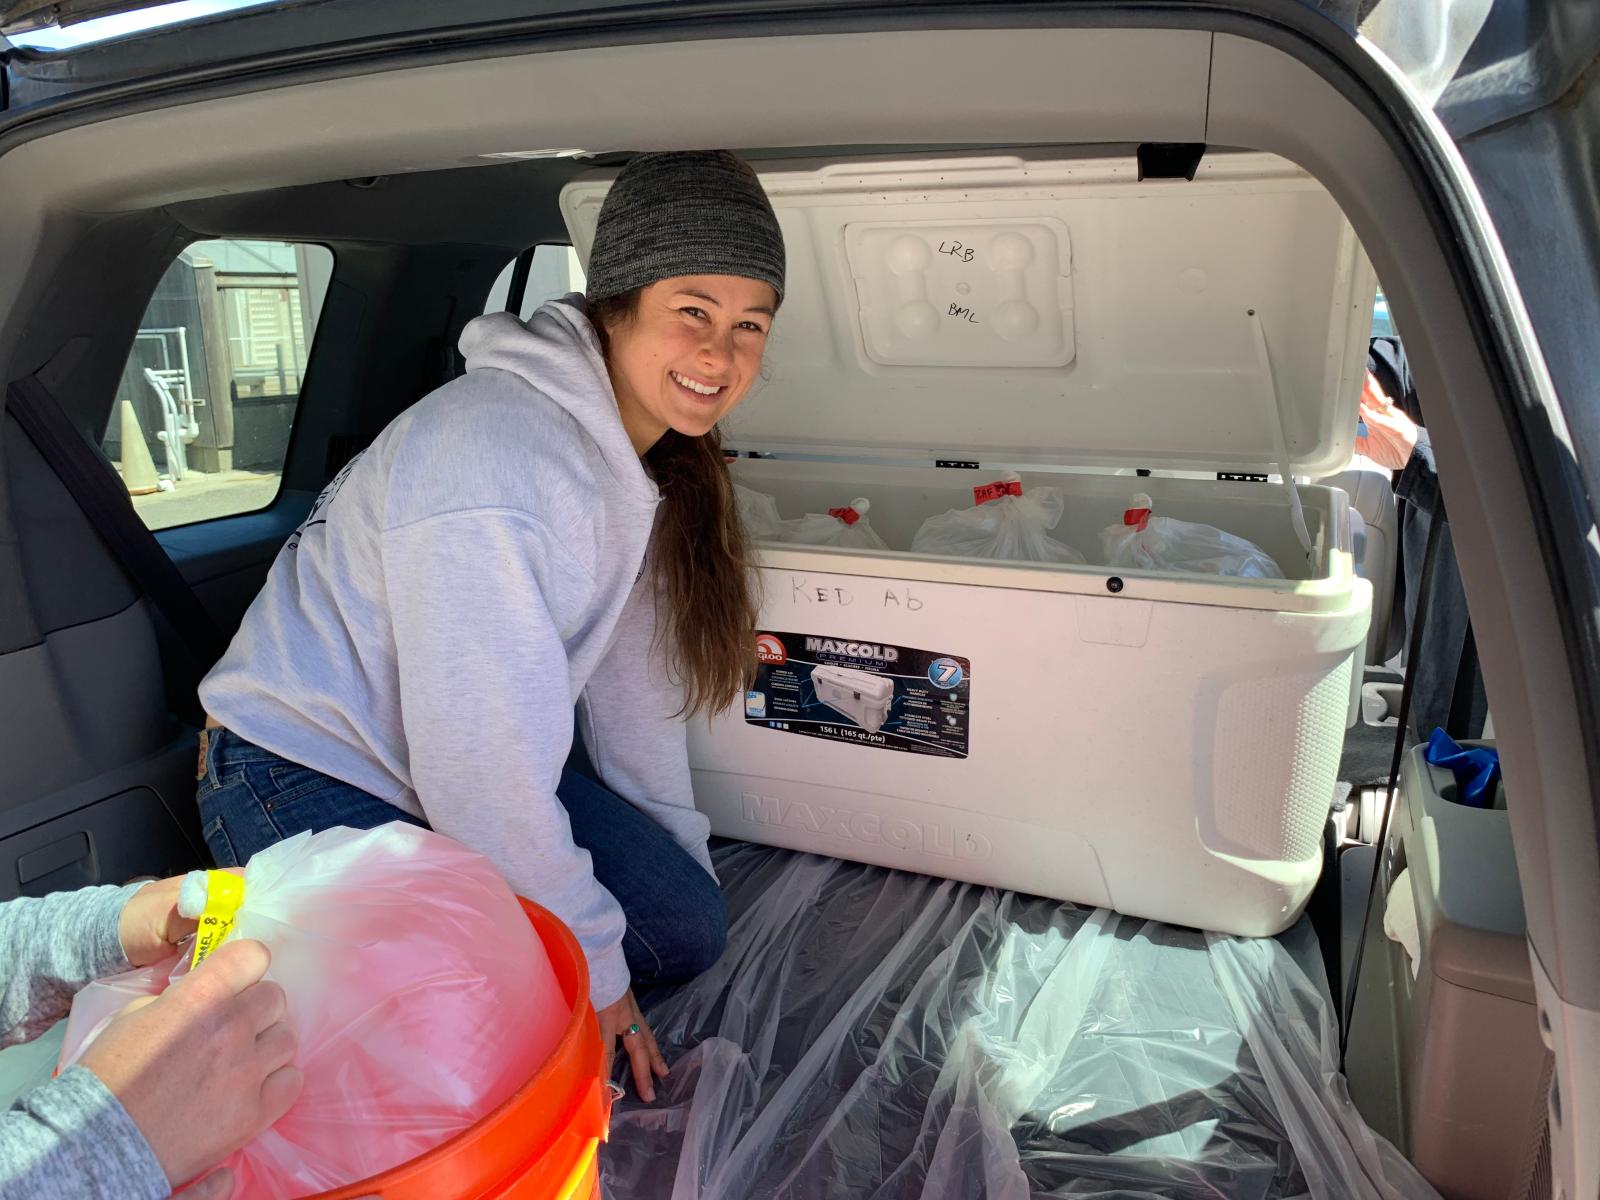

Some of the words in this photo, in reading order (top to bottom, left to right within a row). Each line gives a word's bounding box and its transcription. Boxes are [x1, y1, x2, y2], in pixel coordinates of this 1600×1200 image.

[939, 240, 975, 262] LRB
[948, 302, 980, 323] BML
[806, 637, 899, 662] MAXCOLD
[819, 653, 885, 667] PREMIUM
[937, 664, 958, 682] 7
[820, 725, 833, 734] 156
[840, 728, 857, 738] (165
[740, 791, 994, 862] MAXCOLD
[204, 916, 218, 926] 8
